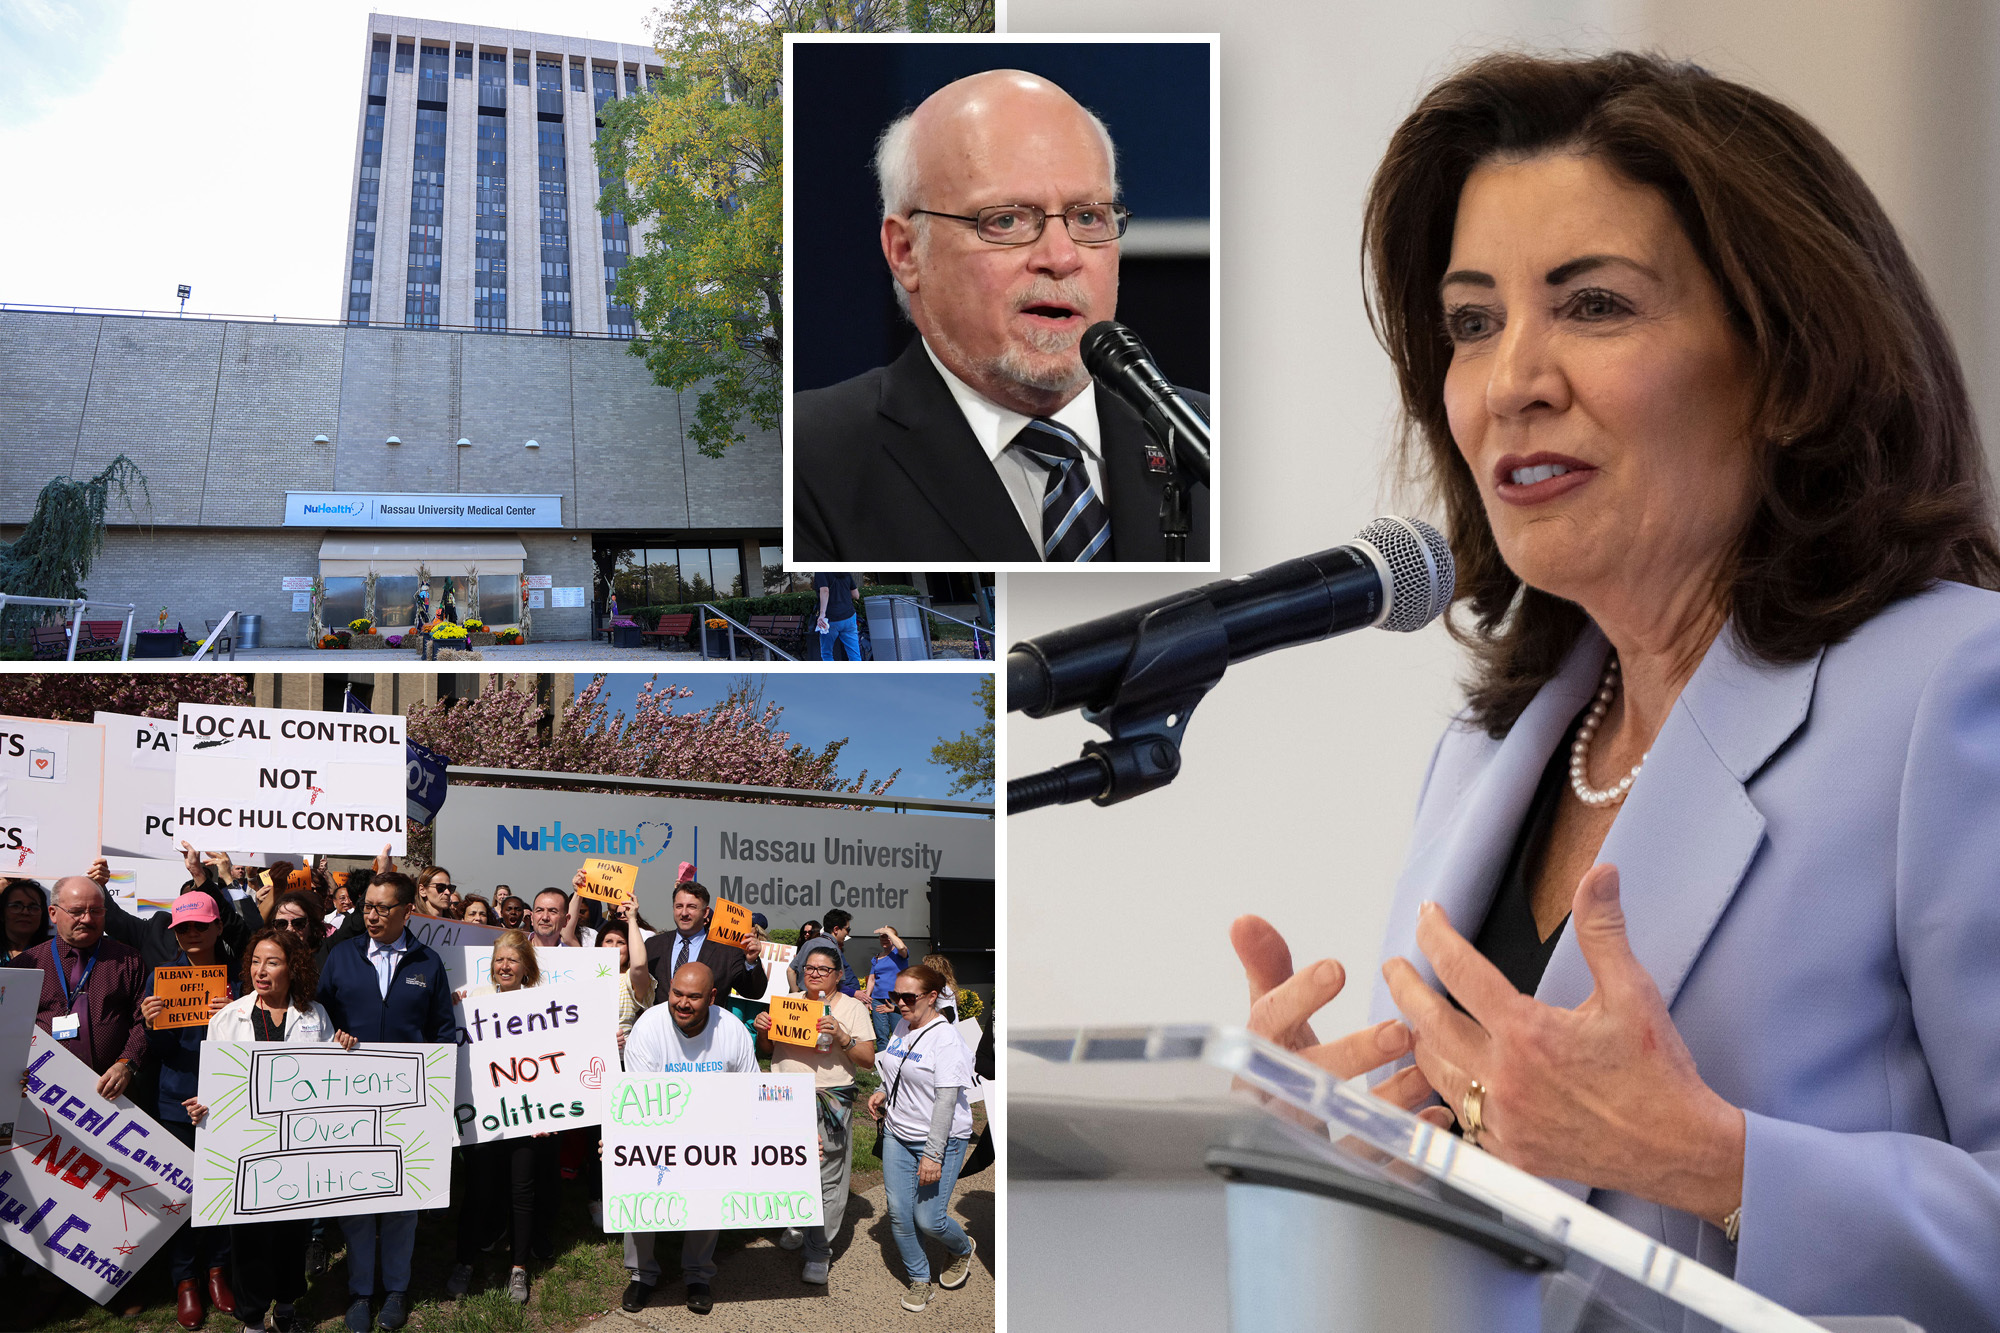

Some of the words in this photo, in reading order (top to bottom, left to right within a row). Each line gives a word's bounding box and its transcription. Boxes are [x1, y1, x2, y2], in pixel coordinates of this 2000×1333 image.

[304, 503, 351, 514] NuHealth
[380, 504, 415, 514] Nassau
[418, 505, 465, 516] University
[467, 506, 503, 515] Medical
[506, 506, 536, 515] Center
[182, 714, 271, 740] LOCAL
[281, 719, 400, 745] CONTROL
[259, 768, 317, 790] NOT
[292, 812, 402, 832] CONTROL
[497, 821, 636, 856] NuHealth
[720, 831, 815, 863] Nassau
[824, 837, 943, 875] University
[597, 862, 623, 874] HONK
[601, 873, 613, 881] for
[586, 882, 623, 900] NUMC
[720, 875, 821, 907] Medical
[830, 879, 909, 909] Center
[726, 904, 745, 918] HONK
[731, 917, 740, 925] for
[158, 970, 193, 980] ALBANY
[201, 969, 224, 978] BACK
[180, 983, 204, 992] OFF!!
[163, 997, 203, 1009] QUALITY
[783, 1000, 808, 1012] HONK
[456, 1000, 579, 1047] atients
[789, 1013, 800, 1021] for
[776, 1024, 811, 1041] NUMC
[489, 1051, 566, 1088] NOT
[695, 1061, 723, 1072] NEEDS
[269, 1055, 412, 1102] Patients
[618, 1083, 682, 1119] AHP
[454, 1094, 585, 1136] Politics
[293, 1116, 371, 1142] Over
[614, 1145, 677, 1167] SAVE
[684, 1145, 737, 1166] OUR
[751, 1145, 808, 1166] JOBS
[31, 1134, 131, 1202] NOT
[247, 1158, 394, 1207] Politics
[619, 1196, 680, 1228] NCCC
[731, 1195, 813, 1221] NUMC
